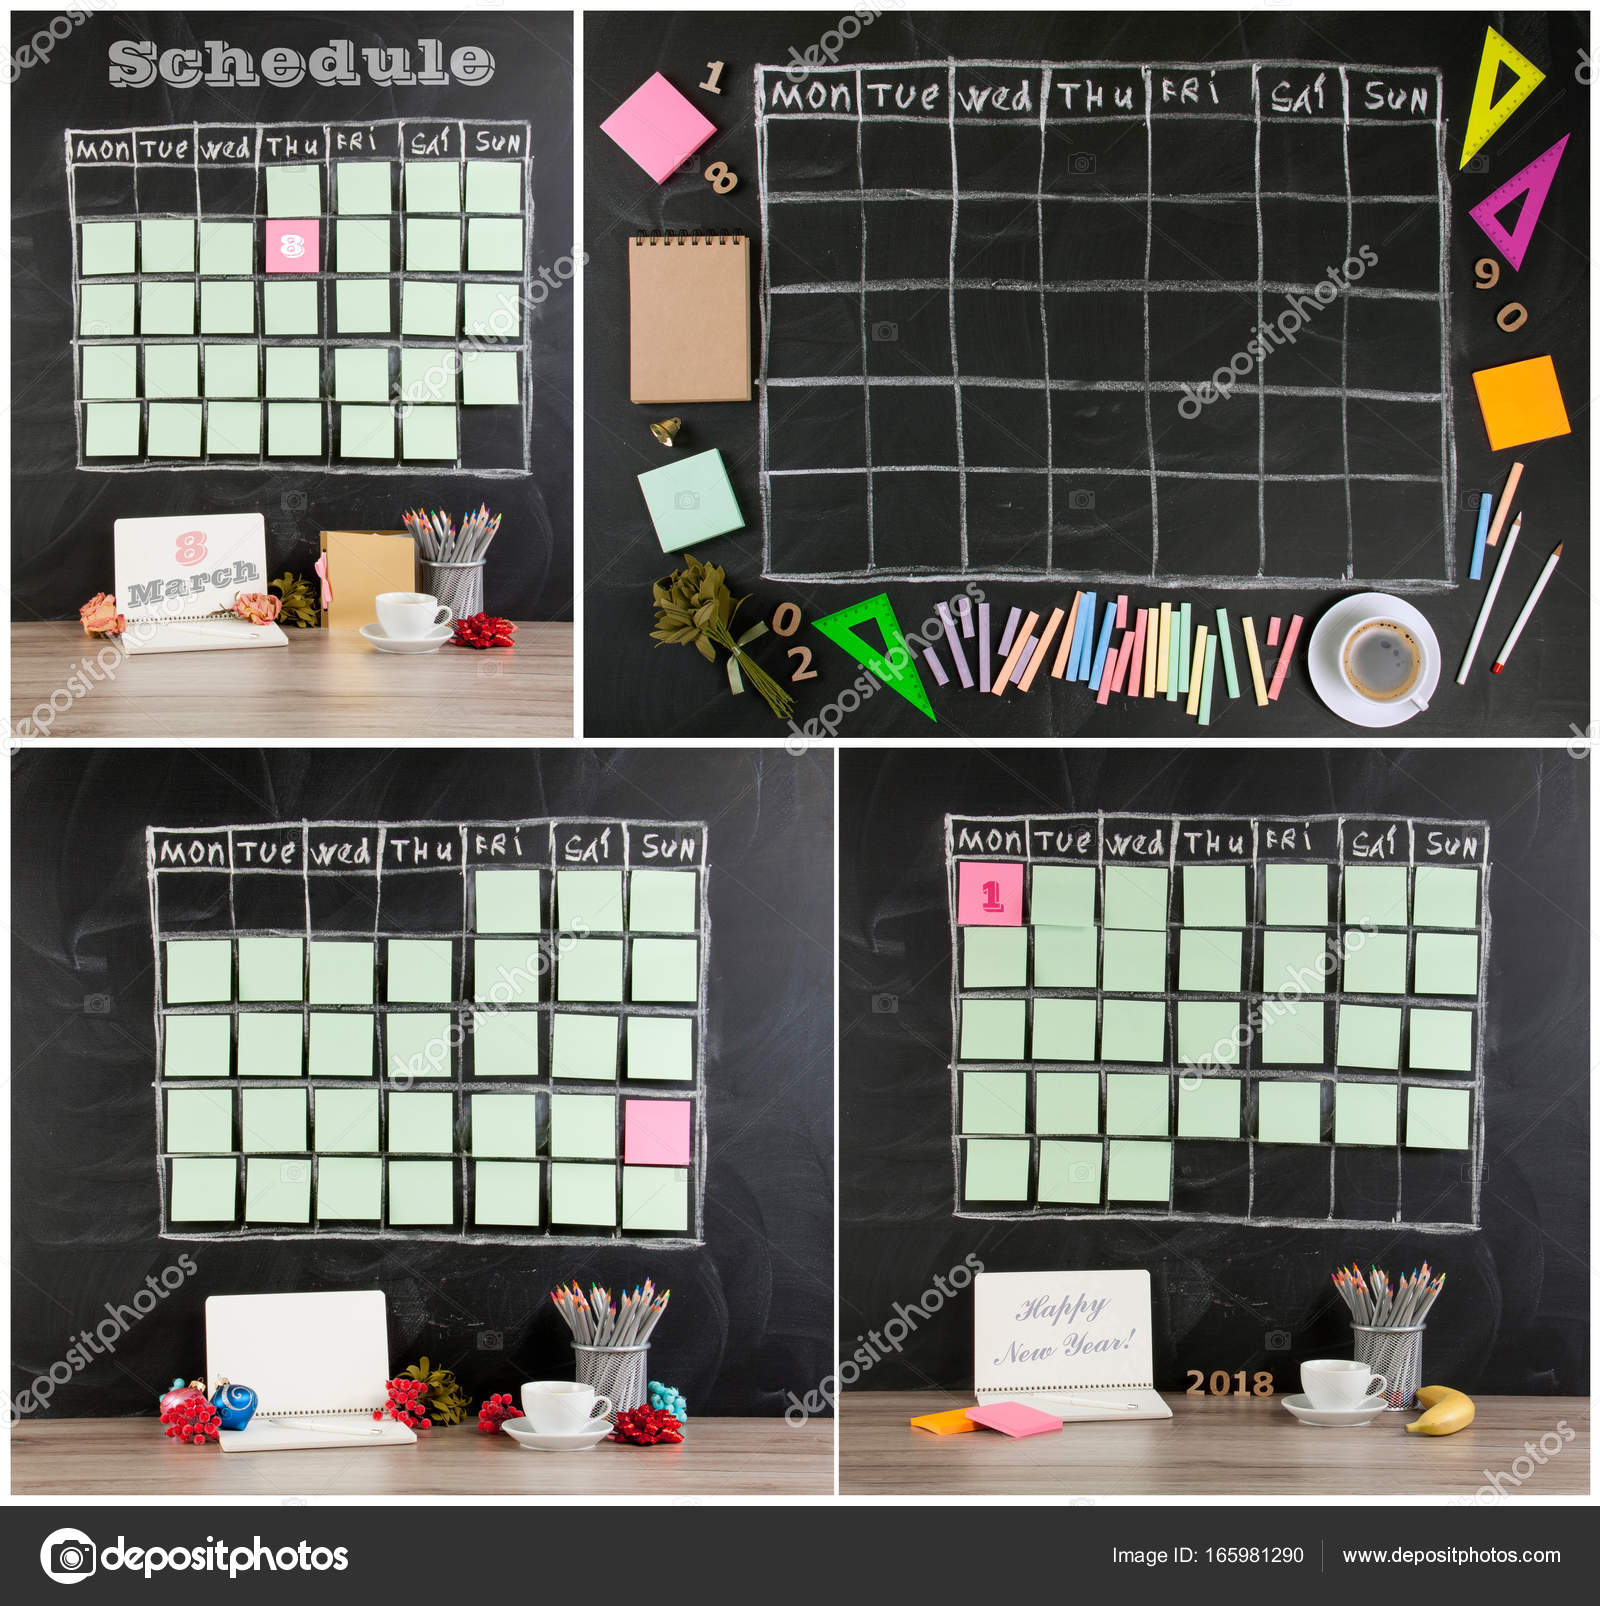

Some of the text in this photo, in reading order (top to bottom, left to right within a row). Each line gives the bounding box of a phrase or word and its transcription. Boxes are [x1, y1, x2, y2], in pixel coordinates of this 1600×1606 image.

[699, 60, 725, 95] 1
[1363, 80, 1429, 114] SUN
[475, 130, 521, 154] SUN
[704, 161, 738, 195] 8
[279, 234, 306, 258] 8
[175, 531, 208, 567] 8
[127, 559, 260, 608] March
[772, 602, 802, 637] 0
[787, 646, 818, 683] 2
[641, 833, 695, 861] SUN
[1426, 831, 1478, 860] SUN
[982, 880, 1004, 913] 1
[1015, 1292, 1112, 1327] Happy
[993, 1328, 1137, 1367] New Year!
[1186, 1370, 1275, 1396] 2018
